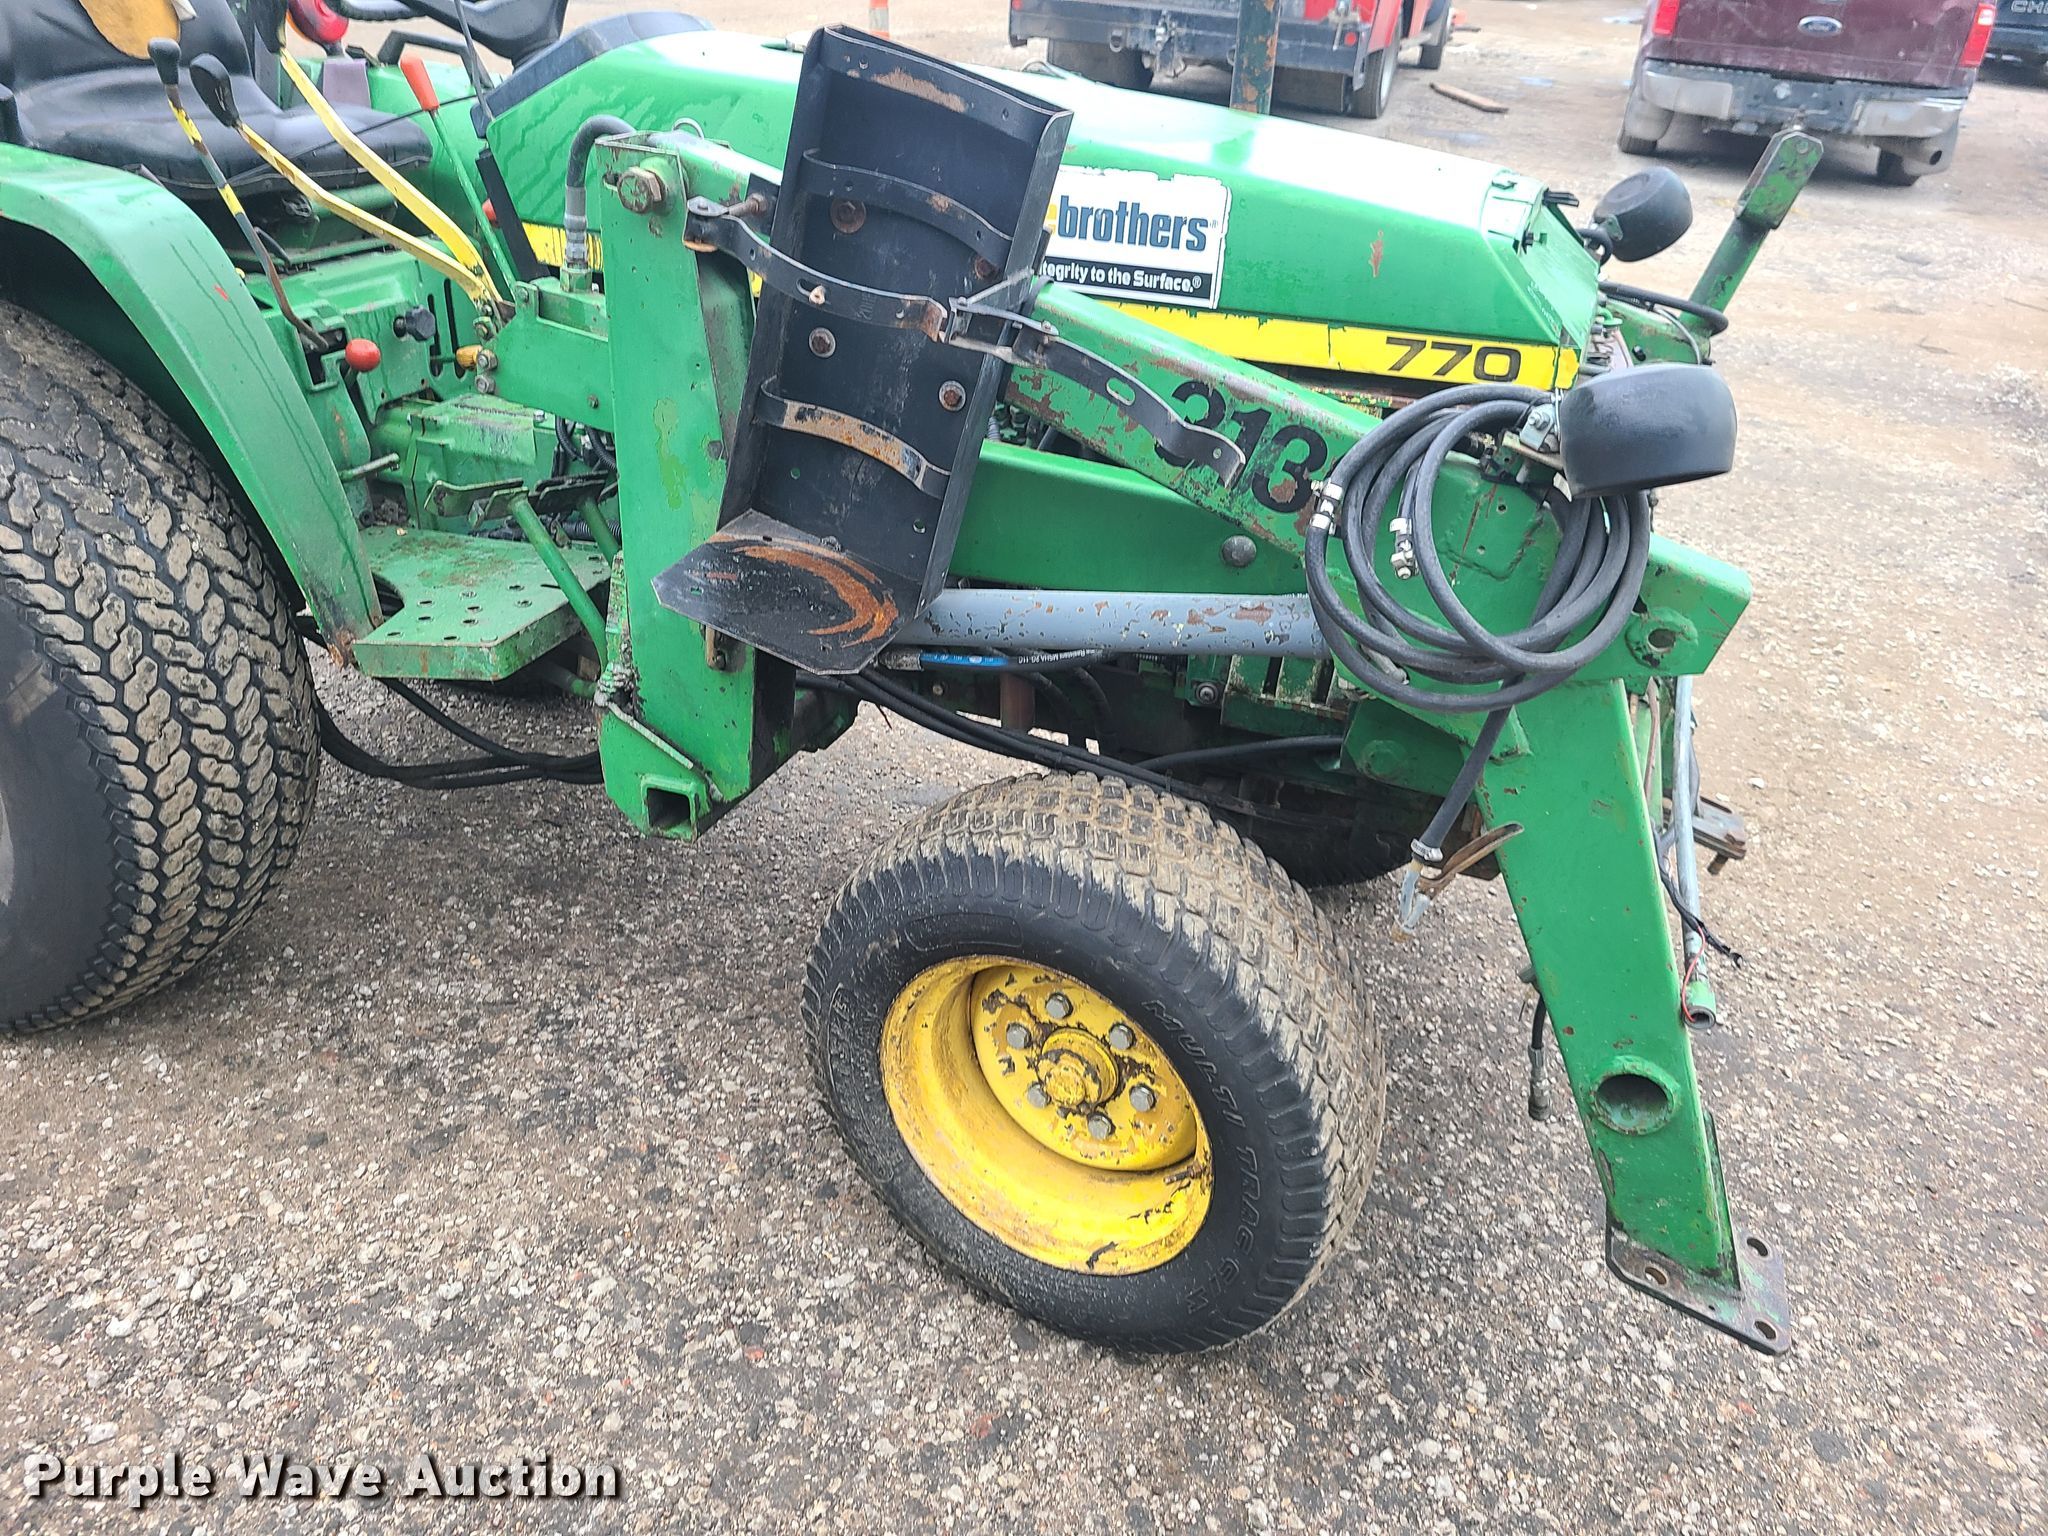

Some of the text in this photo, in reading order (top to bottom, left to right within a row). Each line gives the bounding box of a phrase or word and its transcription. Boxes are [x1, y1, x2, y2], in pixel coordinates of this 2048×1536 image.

[1090, 266, 1105, 283] to
[1108, 267, 1131, 285] the
[1386, 336, 1521, 382] 770
[1141, 999, 1247, 1128] MULTI
[1235, 1145, 1262, 1252] TRAC
